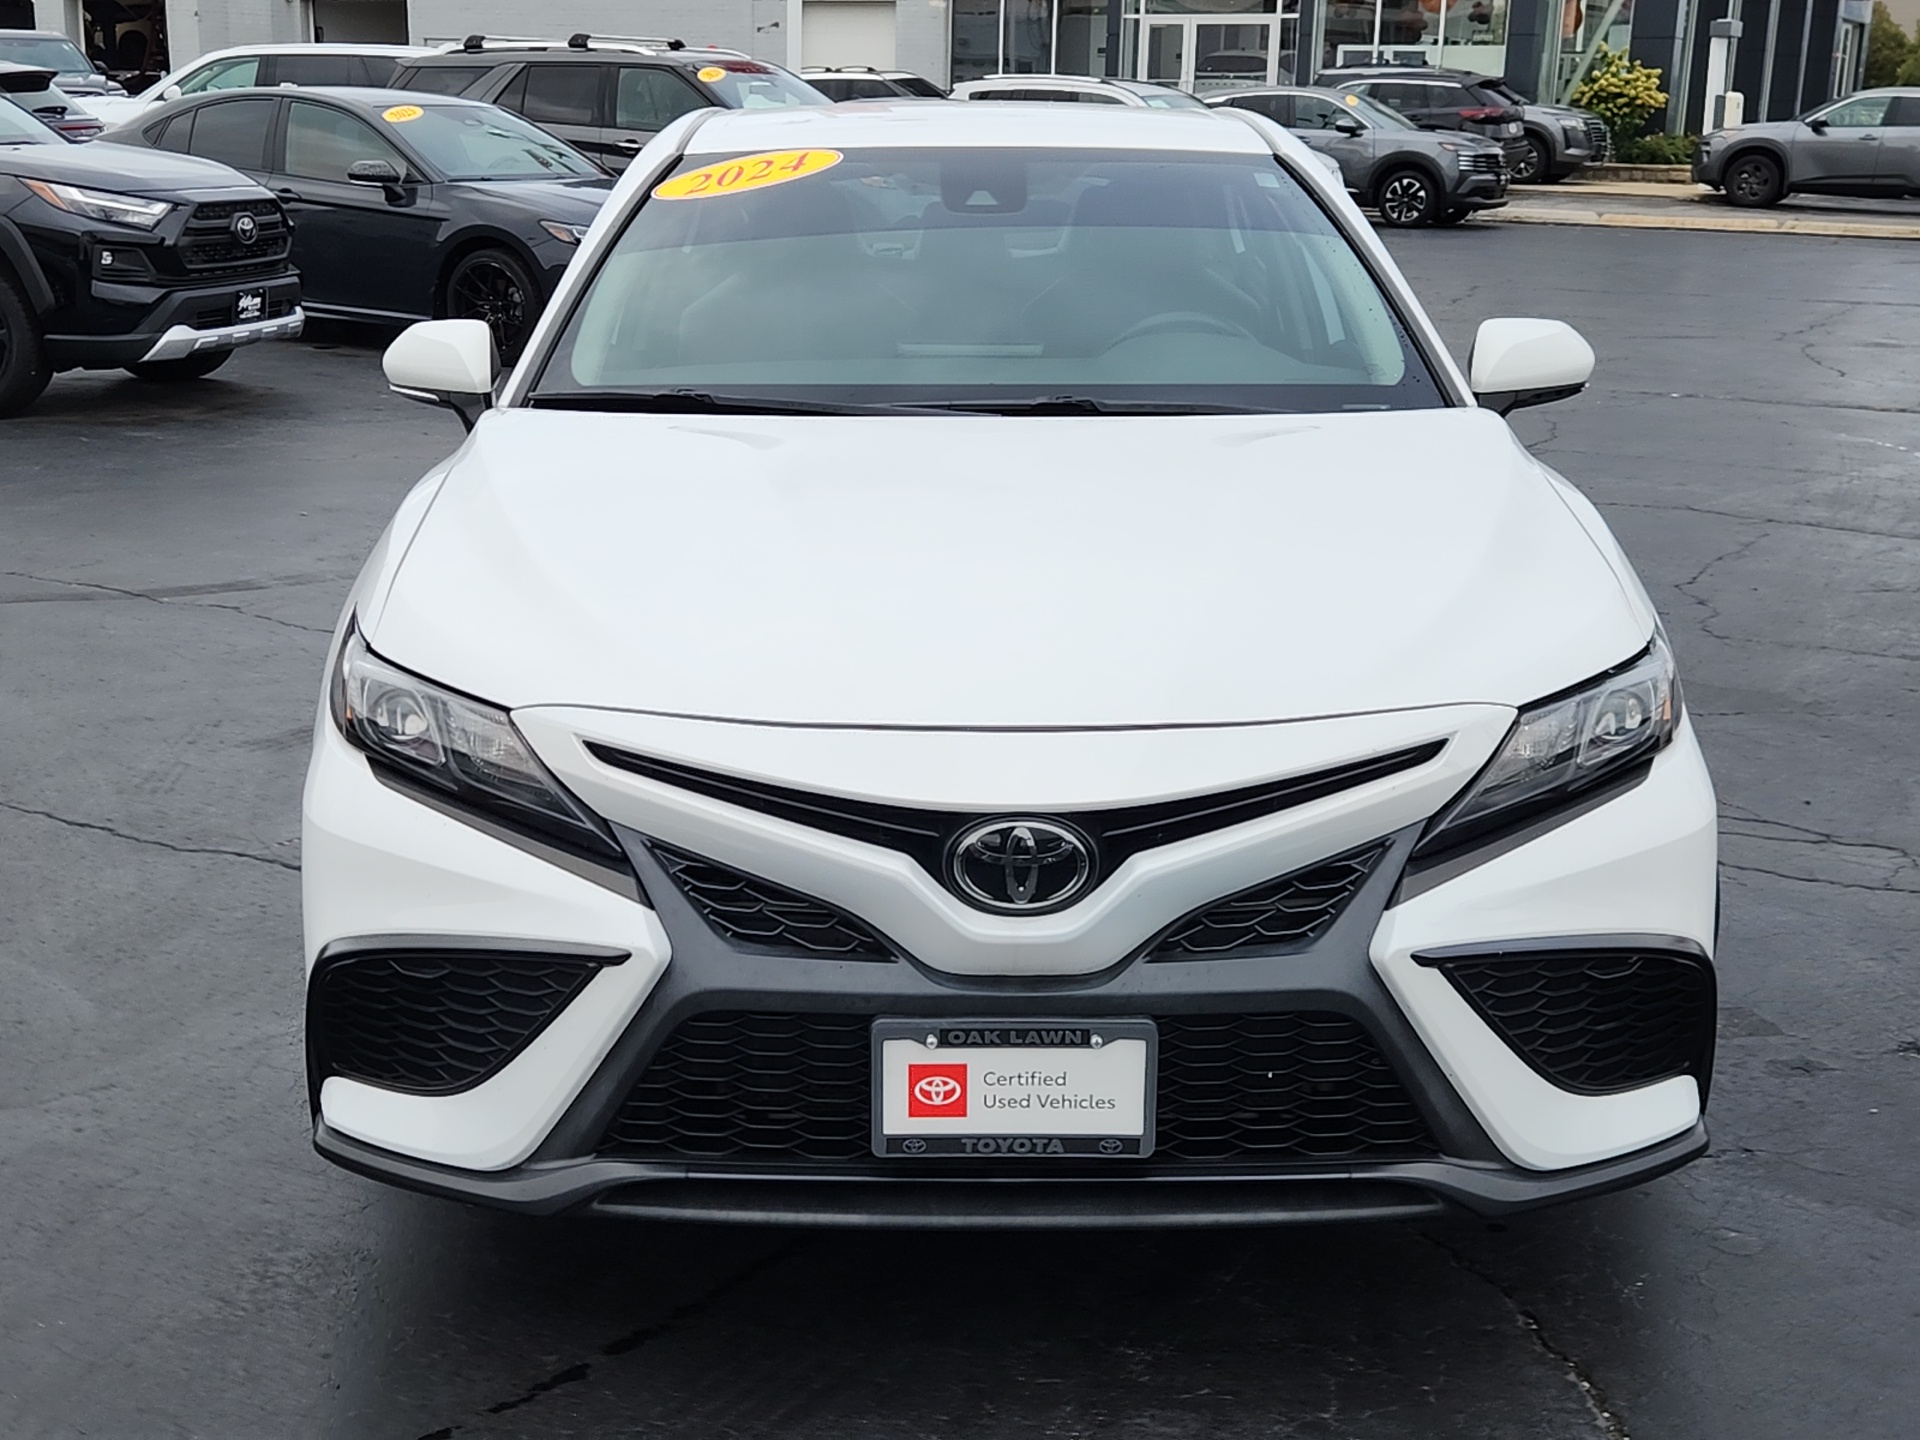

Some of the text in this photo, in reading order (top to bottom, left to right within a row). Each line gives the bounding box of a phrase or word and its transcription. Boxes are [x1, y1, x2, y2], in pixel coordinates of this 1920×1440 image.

[684, 152, 810, 195] 2024
[947, 1030, 1082, 1045] OAK LAWN
[983, 1071, 1067, 1087] Certified
[983, 1094, 1116, 1110] Used Vehicles
[961, 1138, 1065, 1154] TOYOTA
